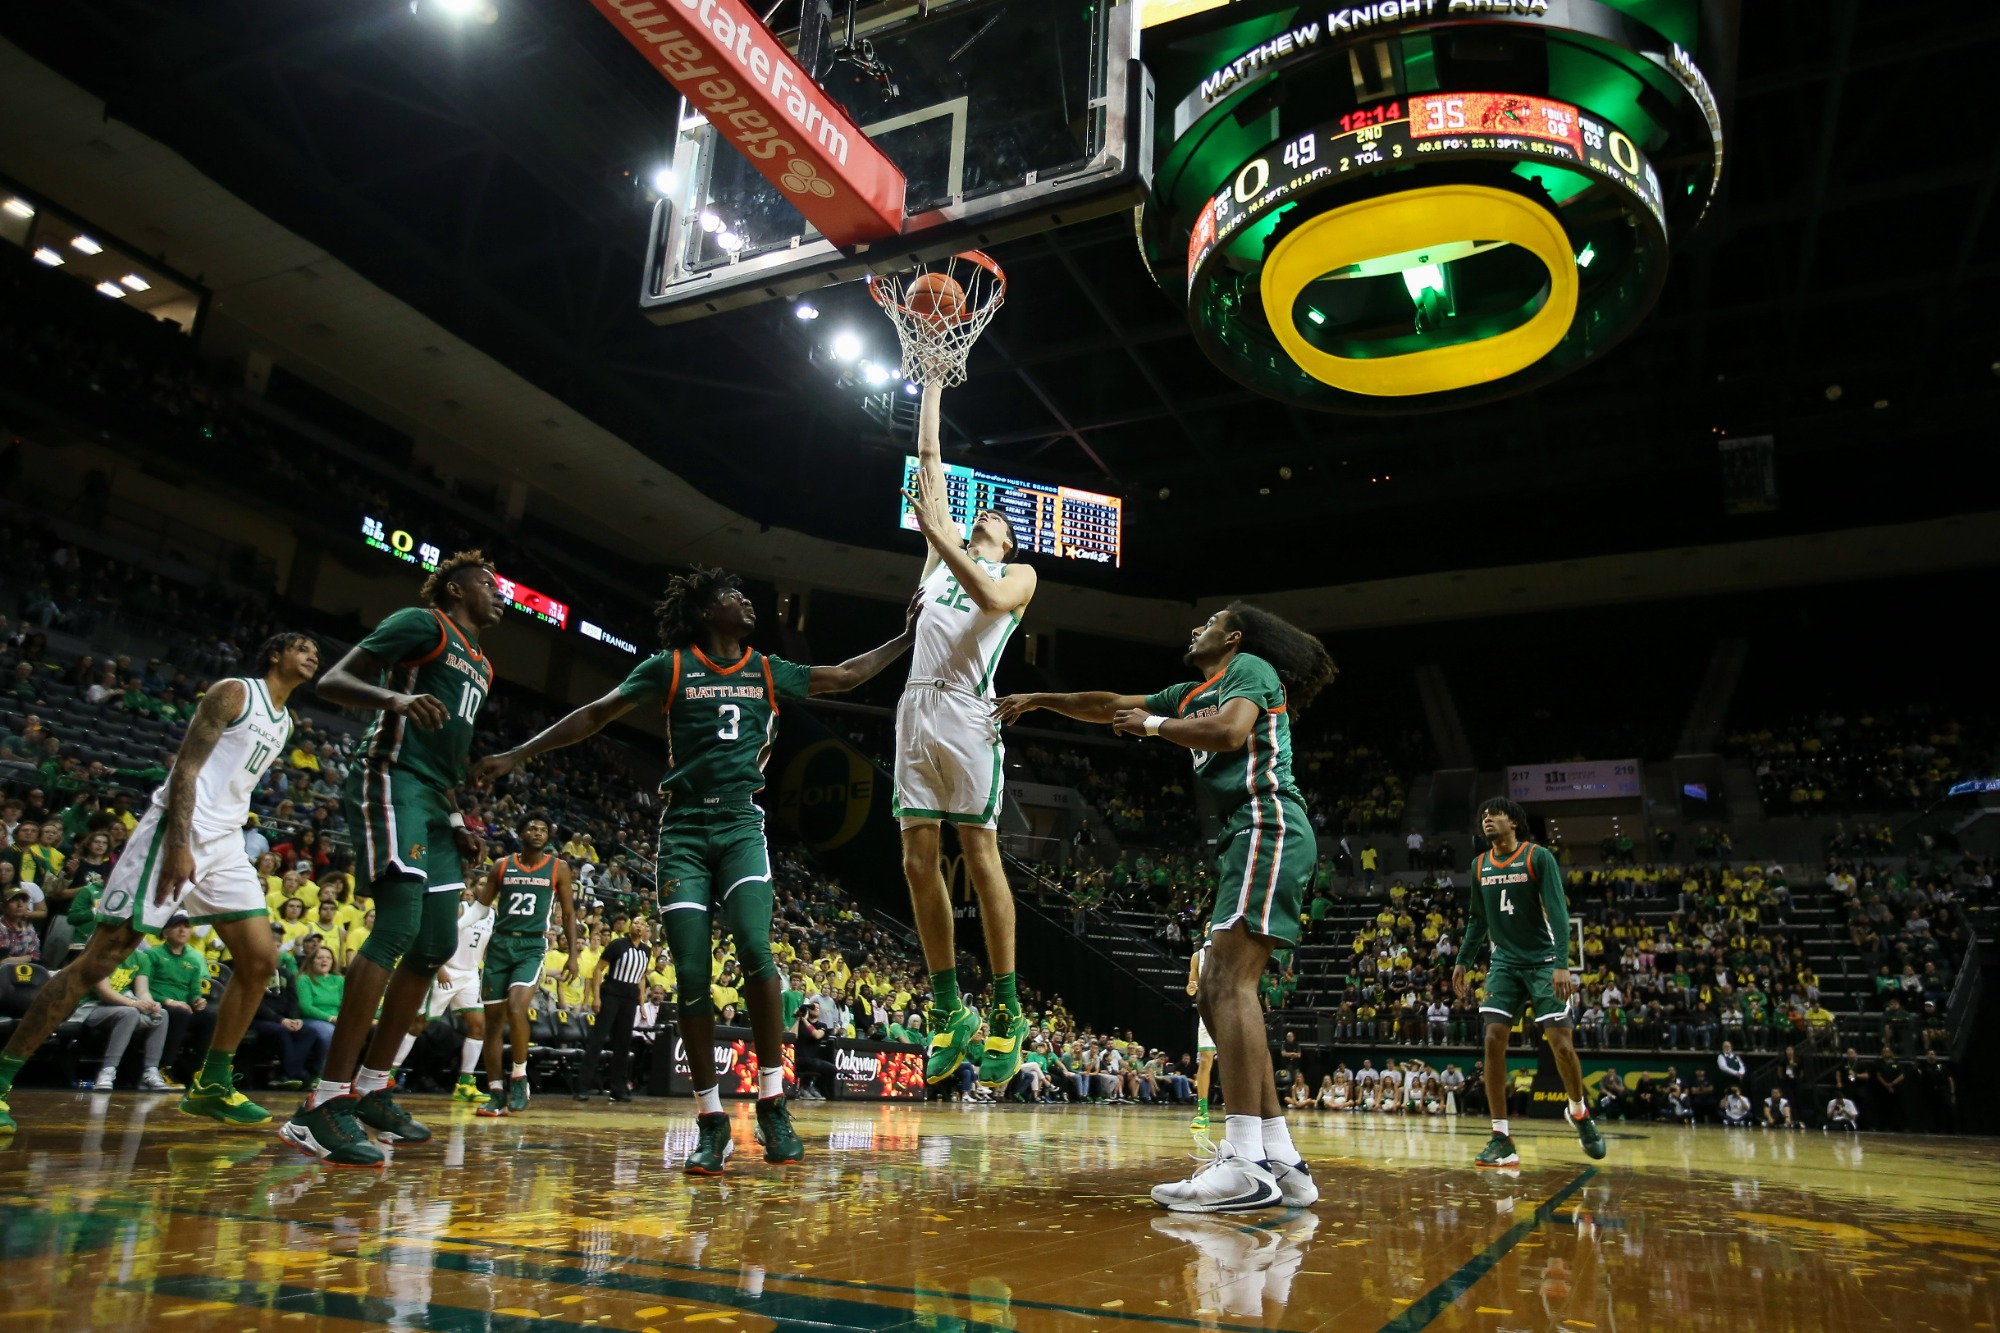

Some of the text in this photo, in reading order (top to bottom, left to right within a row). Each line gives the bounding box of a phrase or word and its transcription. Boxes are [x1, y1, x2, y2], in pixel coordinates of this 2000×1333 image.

[1200, 22, 1320, 102] MATTHEW
[1327, 0, 1439, 37] KNIGHT
[1339, 101, 1400, 131] 12:14
[1425, 99, 1465, 130] 35
[1356, 126, 1382, 143] 2ND
[1547, 121, 1568, 137] 08
[1283, 133, 1316, 169] 49
[1340, 144, 1402, 171] 2 TOL 3
[419, 542, 440, 566] 49
[498, 577, 516, 600] 35
[602, 631, 637, 655] FRANKLIN
[458, 680, 482, 725] 10
[685, 685, 764, 699] RATTLERS
[718, 704, 741, 740] 3
[248, 723, 282, 749] DUCKS
[244, 740, 271, 775] 10
[503, 877, 550, 887] RATTLERS
[1481, 873, 1528, 886] RATTLERS
[508, 892, 537, 916] 23
[1500, 889, 1514, 915] 4
[469, 931, 481, 949] 3
[835, 1048, 877, 1081] Oakway
